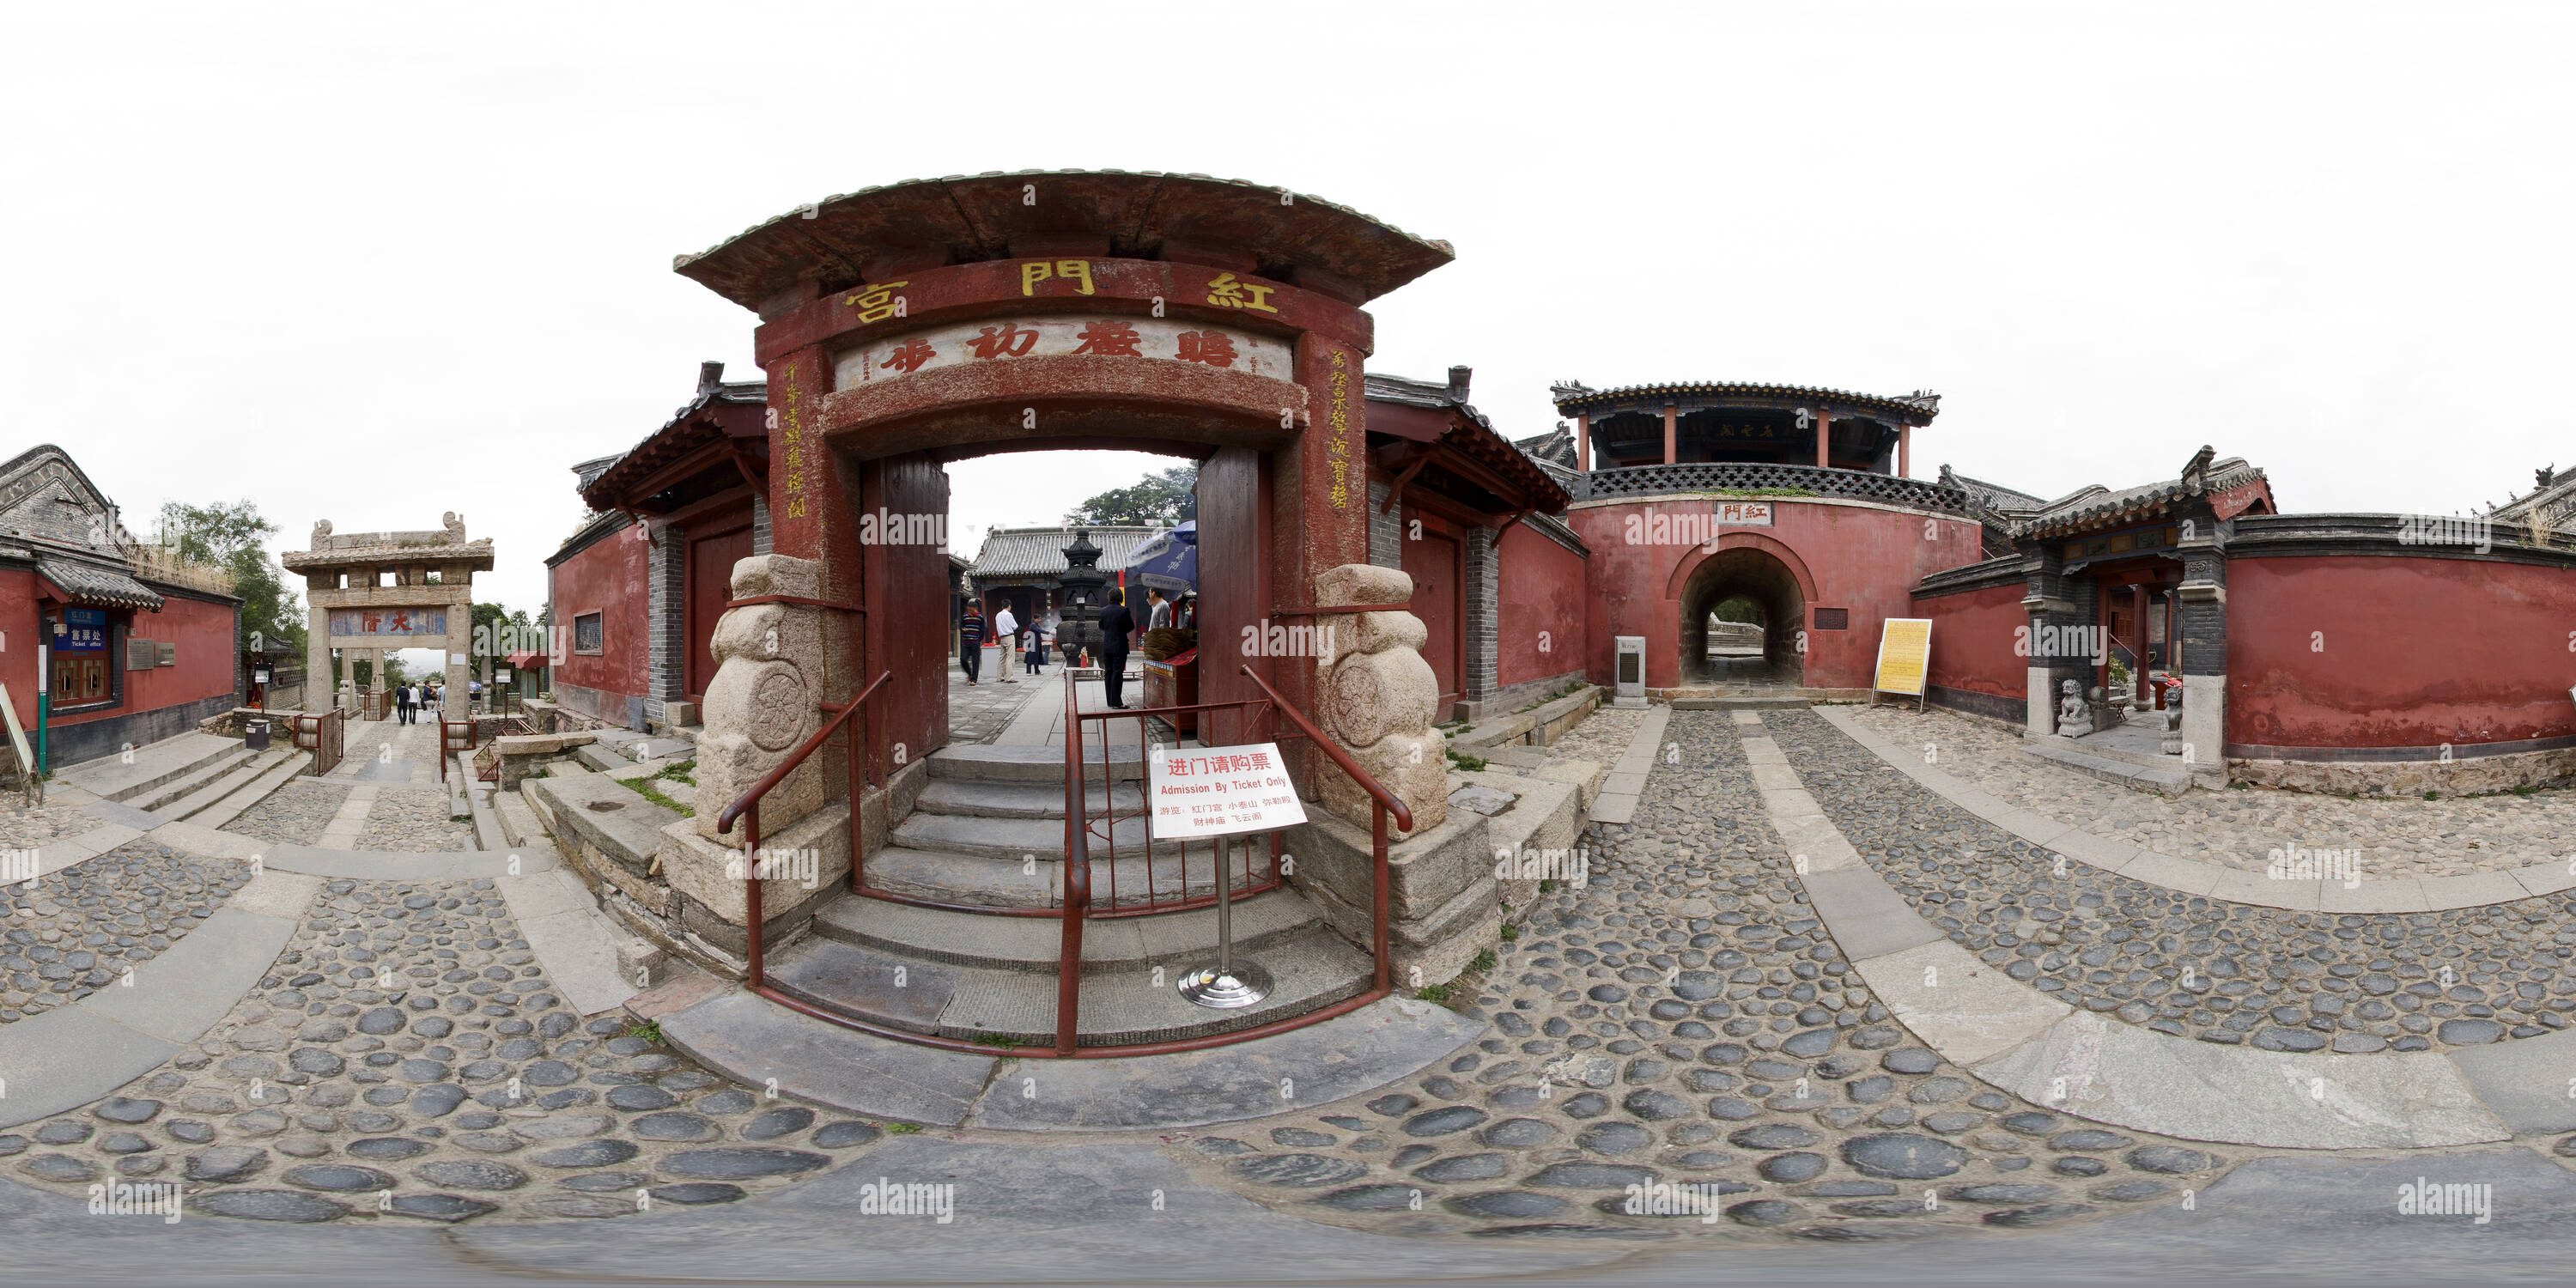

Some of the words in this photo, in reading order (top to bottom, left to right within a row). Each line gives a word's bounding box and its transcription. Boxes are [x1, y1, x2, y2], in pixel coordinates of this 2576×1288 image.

[71, 629, 101, 641] 售票处
[1168, 752, 1272, 776] 进门请购票
[1161, 783, 1210, 795] Admission
[1216, 782, 1227, 793] By
[1232, 779, 1262, 790] Ticket
[1267, 775, 1286, 787] Only
[1228, 799, 1258, 811] 小泰山
